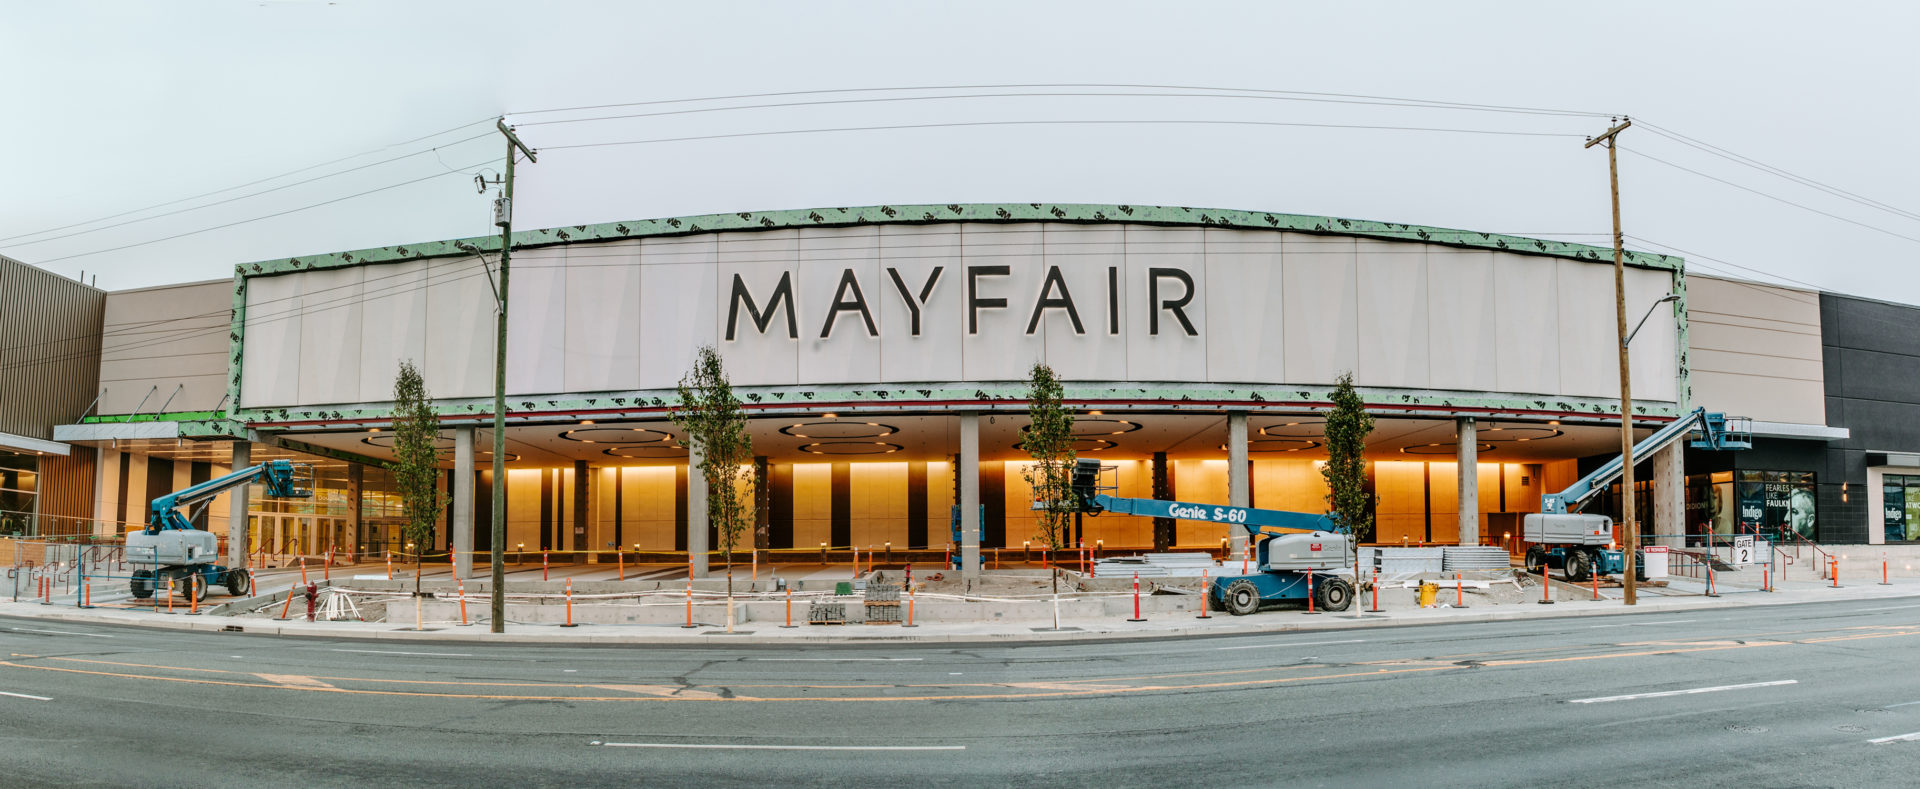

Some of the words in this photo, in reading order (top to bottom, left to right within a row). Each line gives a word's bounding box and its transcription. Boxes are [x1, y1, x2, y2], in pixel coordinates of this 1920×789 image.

[809, 211, 824, 224] 3M
[880, 205, 897, 219] 3M
[995, 207, 1012, 220] 3M
[1050, 205, 1067, 219] 3M
[1264, 212, 1279, 227] 3M
[616, 224, 630, 236] 3M
[725, 265, 1199, 341] MAYFAIR
[1168, 503, 1208, 521] Genie
[1213, 506, 1247, 523] S-60
[1742, 505, 1763, 520] Indigo
[1736, 540, 1752, 549] GATE
[1741, 549, 1748, 562] 2
